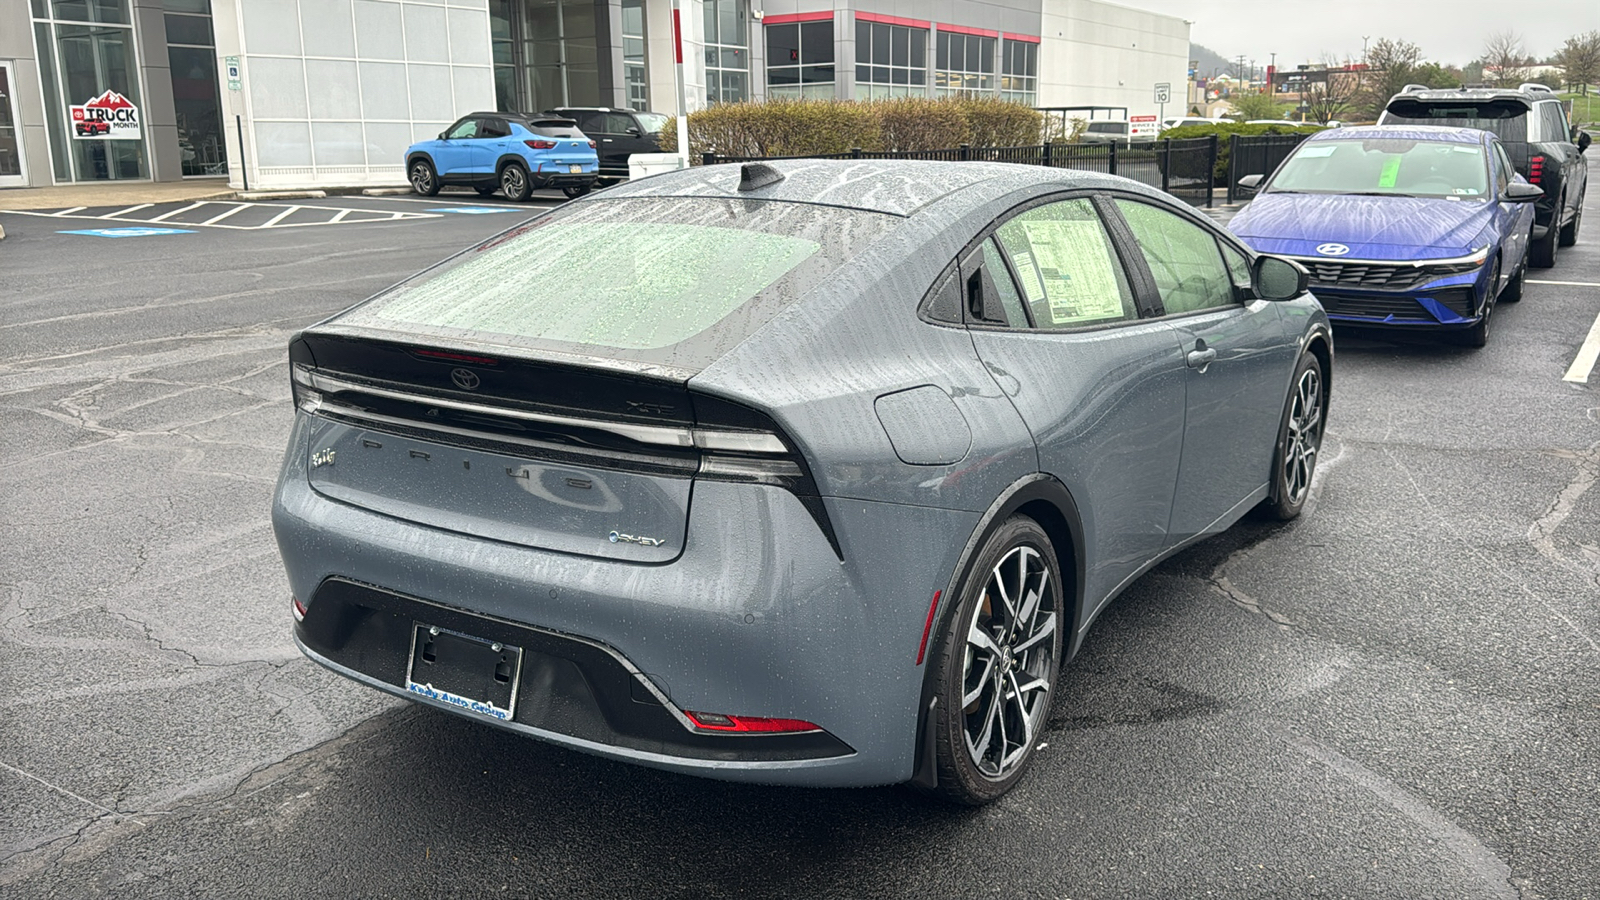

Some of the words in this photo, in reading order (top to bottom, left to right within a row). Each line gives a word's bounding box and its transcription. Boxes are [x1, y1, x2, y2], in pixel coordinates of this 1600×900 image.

[1157, 93, 1167, 101] 10
[86, 108, 136, 122] TRUCK
[363, 438, 592, 490] PRIUS
[441, 693, 469, 710] Auto
[471, 702, 507, 719] Group
